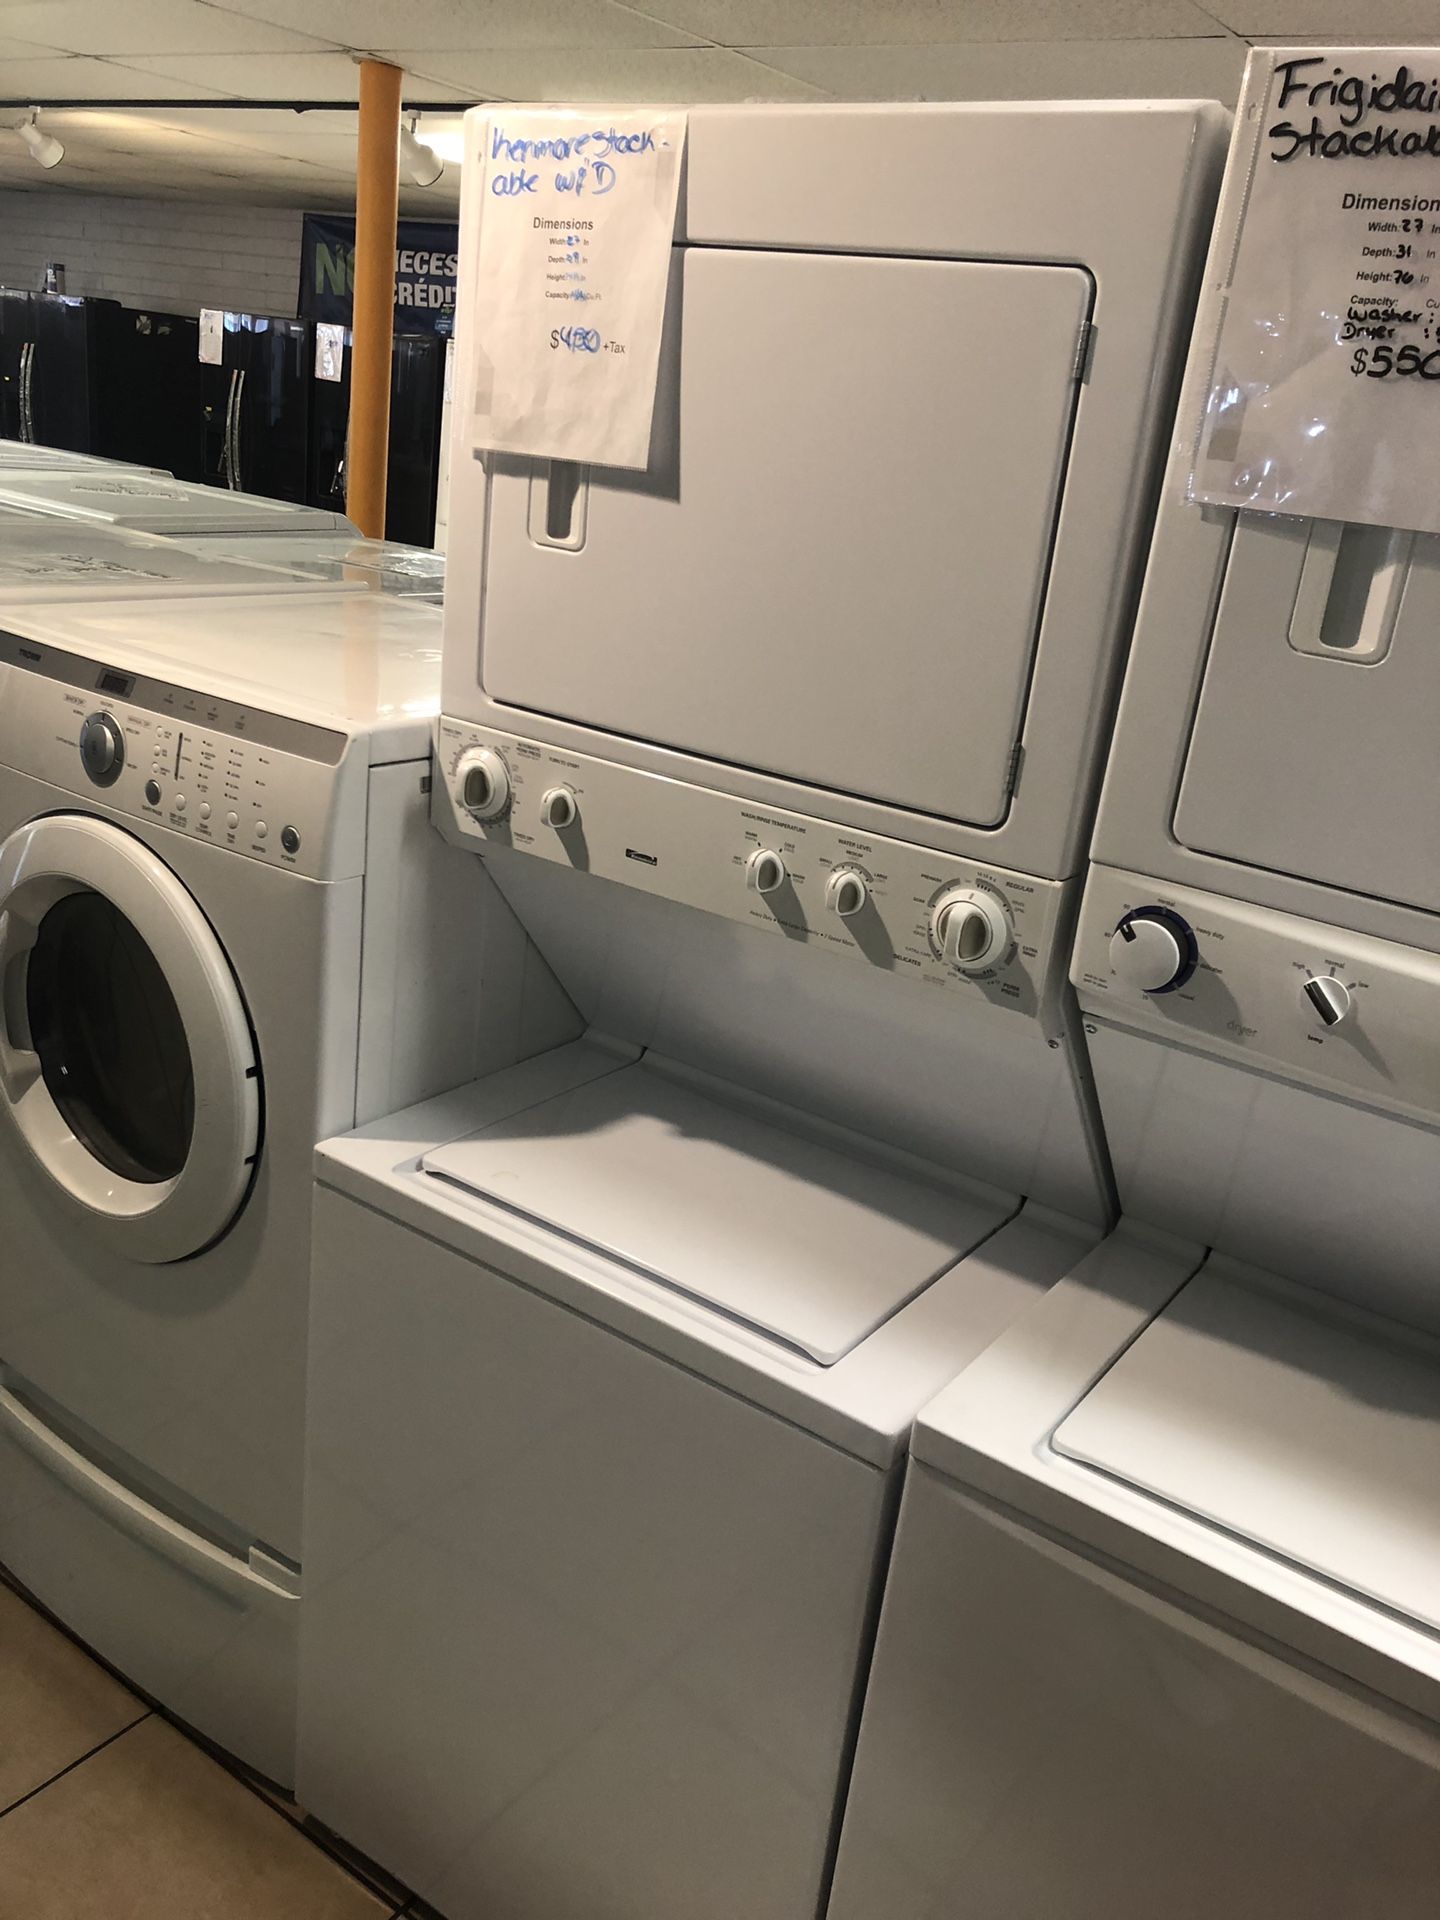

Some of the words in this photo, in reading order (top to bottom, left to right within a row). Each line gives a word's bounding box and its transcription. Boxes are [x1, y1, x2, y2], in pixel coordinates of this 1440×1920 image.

[1275, 57, 1440, 126] Frigidai
[492, 168, 539, 196] able
[533, 217, 594, 230] Dimensions
[1368, 222, 1400, 232] Width:
[1402, 218, 1424, 233] 27
[1362, 246, 1396, 258] Depth:
[1396, 244, 1411, 259] 31
[1426, 250, 1436, 259] In
[395, 250, 458, 277] ECES
[1356, 271, 1392, 283] Height:
[1420, 274, 1429, 283] In
[393, 277, 457, 309] RÉDI
[1351, 295, 1398, 308] Capacity:
[1341, 322, 1395, 340] Dryer
[856, 843, 873, 853] LEVEL
[1005, 881, 1034, 893] REGULAR
[1226, 1019, 1258, 1038] dryer
[1307, 1034, 1323, 1044] temp
